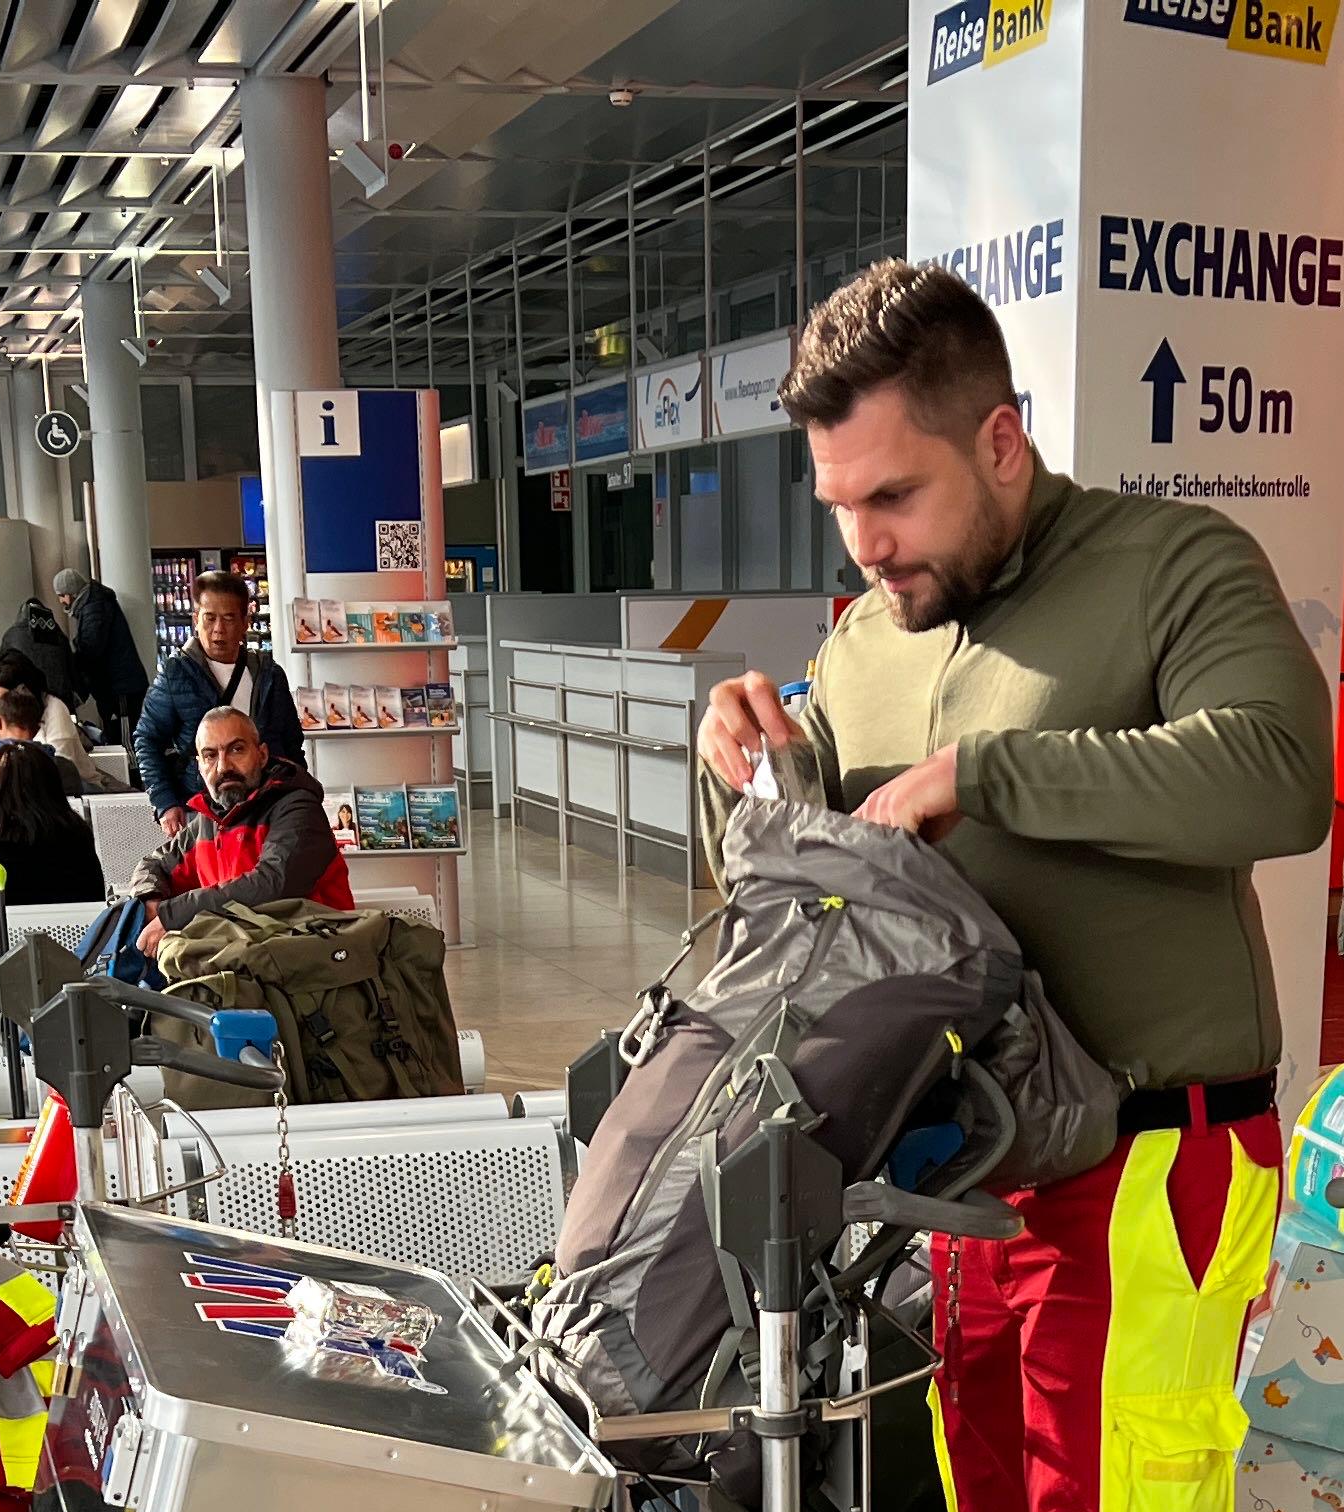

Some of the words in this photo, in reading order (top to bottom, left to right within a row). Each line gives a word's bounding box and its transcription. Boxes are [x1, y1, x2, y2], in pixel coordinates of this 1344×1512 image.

[933, 10, 985, 71] Reise
[992, 0, 1044, 51] Bank
[1244, 0, 1323, 52] Bank
[918, 218, 1064, 307] CHANGE
[1098, 214, 1344, 307] EXCHANGE
[1199, 365, 1254, 435] 50
[1258, 388, 1294, 435] m
[1119, 473, 1143, 495] bei
[1145, 473, 1170, 497] der
[1172, 473, 1311, 498] Sicherheitskontrolle
